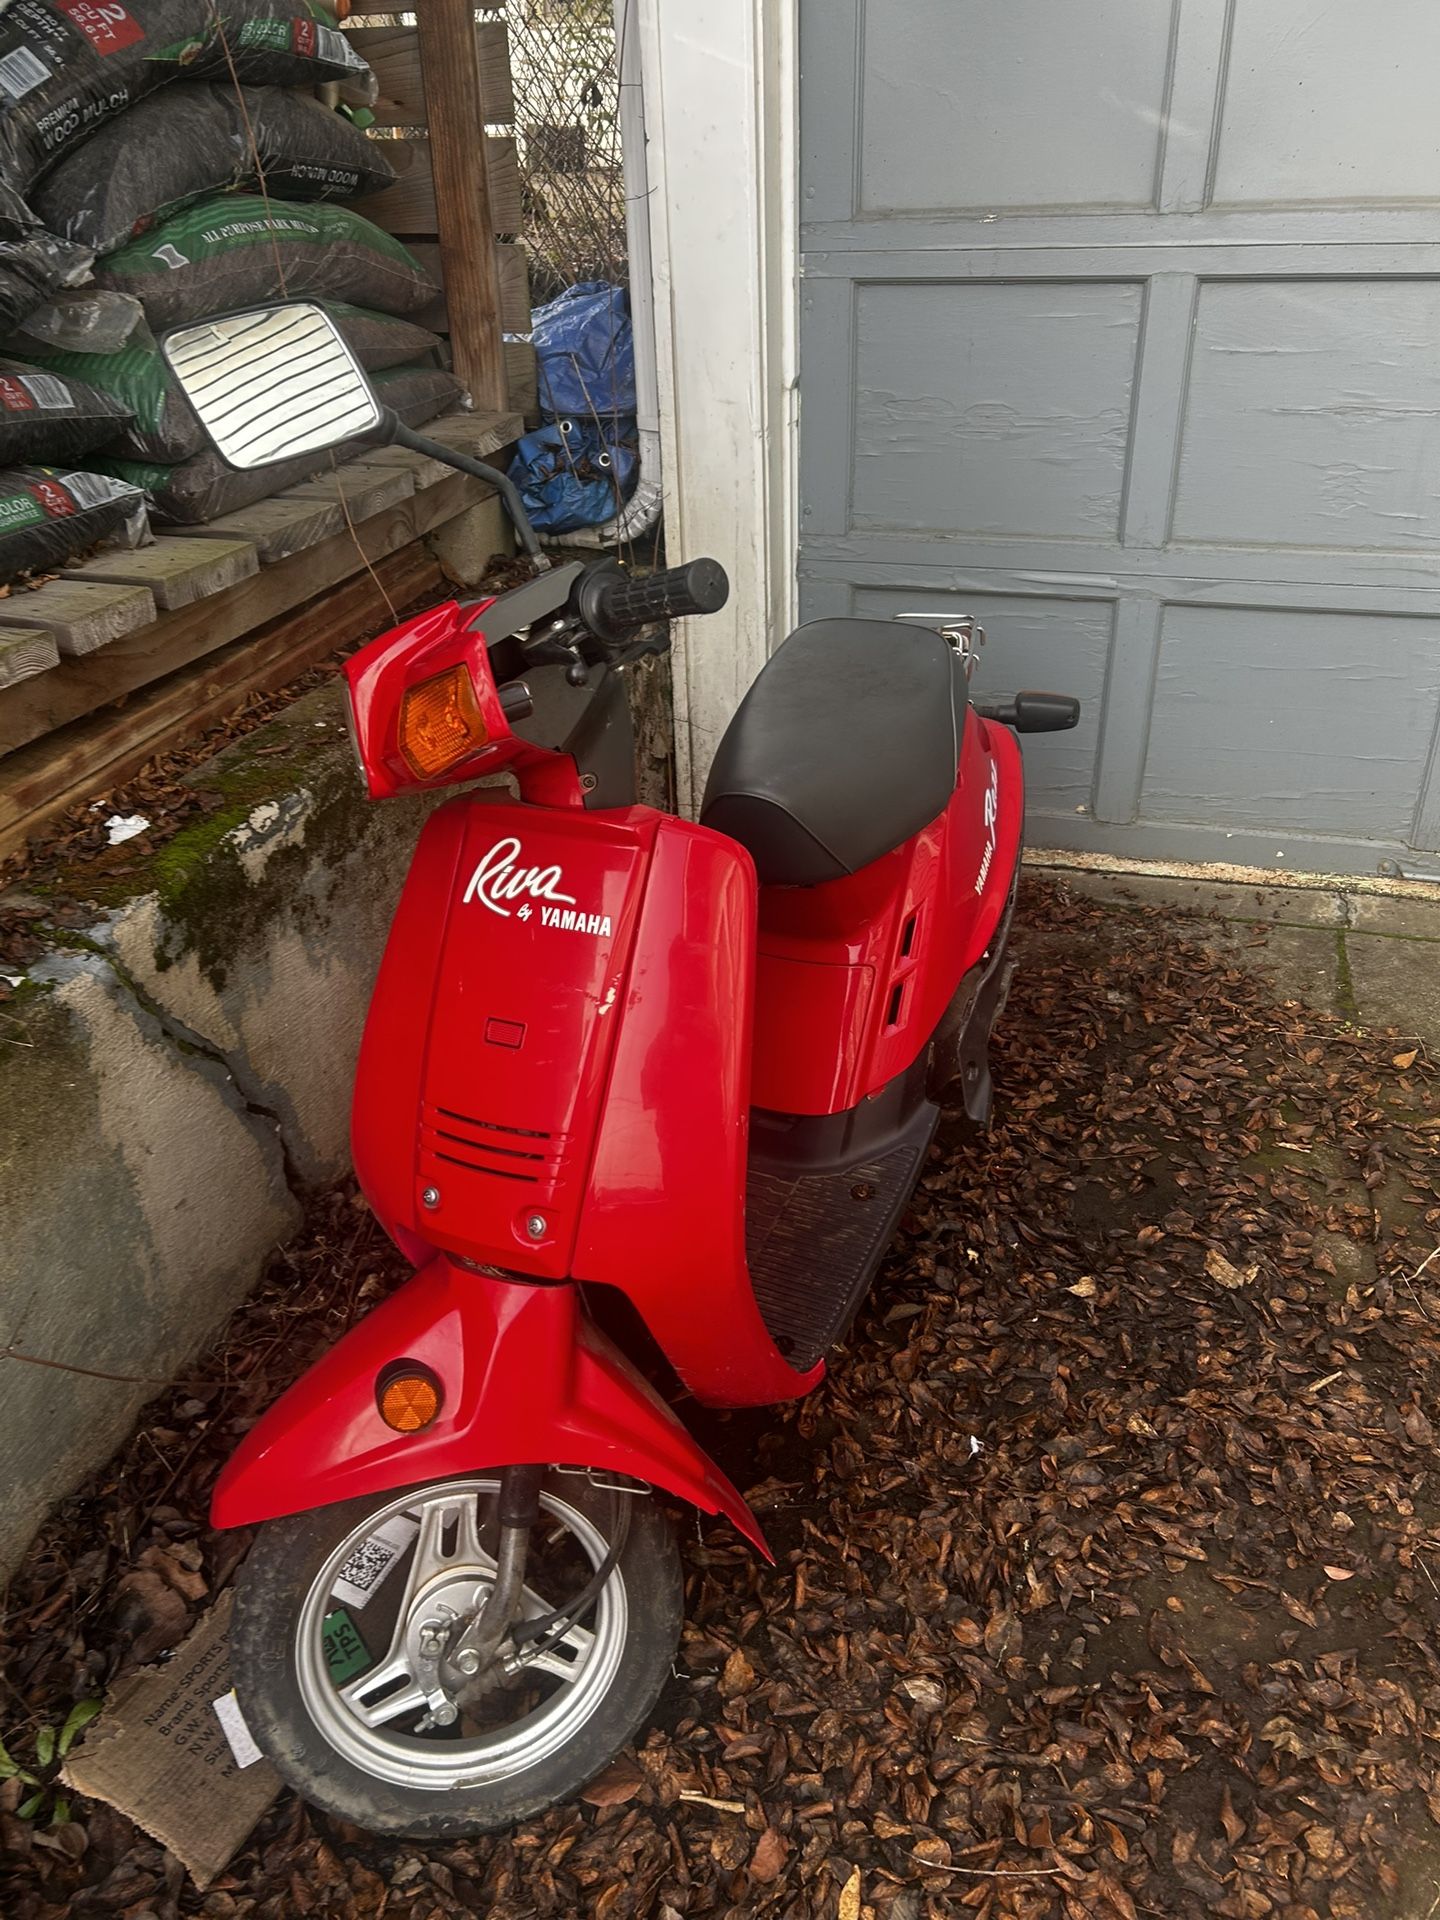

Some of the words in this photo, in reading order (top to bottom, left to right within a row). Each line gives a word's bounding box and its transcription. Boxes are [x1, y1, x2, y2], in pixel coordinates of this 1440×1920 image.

[7, 12, 18, 20] 2
[15, 19, 30, 30] CU
[27, 29, 41, 40] FT
[68, 8, 97, 34] 56.6
[92, 35, 101, 43] L
[79, 2, 100, 19] CU
[97, 22, 116, 39] FT
[96, 3, 126, 25] 2
[36, 97, 79, 134] PREMIUM
[43, 113, 80, 150] WOOD
[83, 88, 129, 122] MULCH
[291, 164, 326, 181] MULCH
[328, 169, 359, 186] WOOD
[39, 485, 57, 497] 2
[463, 837, 576, 917] Riva
[974, 840, 994, 896] YAMAHA
[541, 905, 611, 937] YAMAHA
[333, 1623, 361, 1660] TPS
[143, 1687, 184, 1727] Name:
[180, 1643, 223, 1688] SPORTS
[158, 1698, 197, 1737] Brand:
